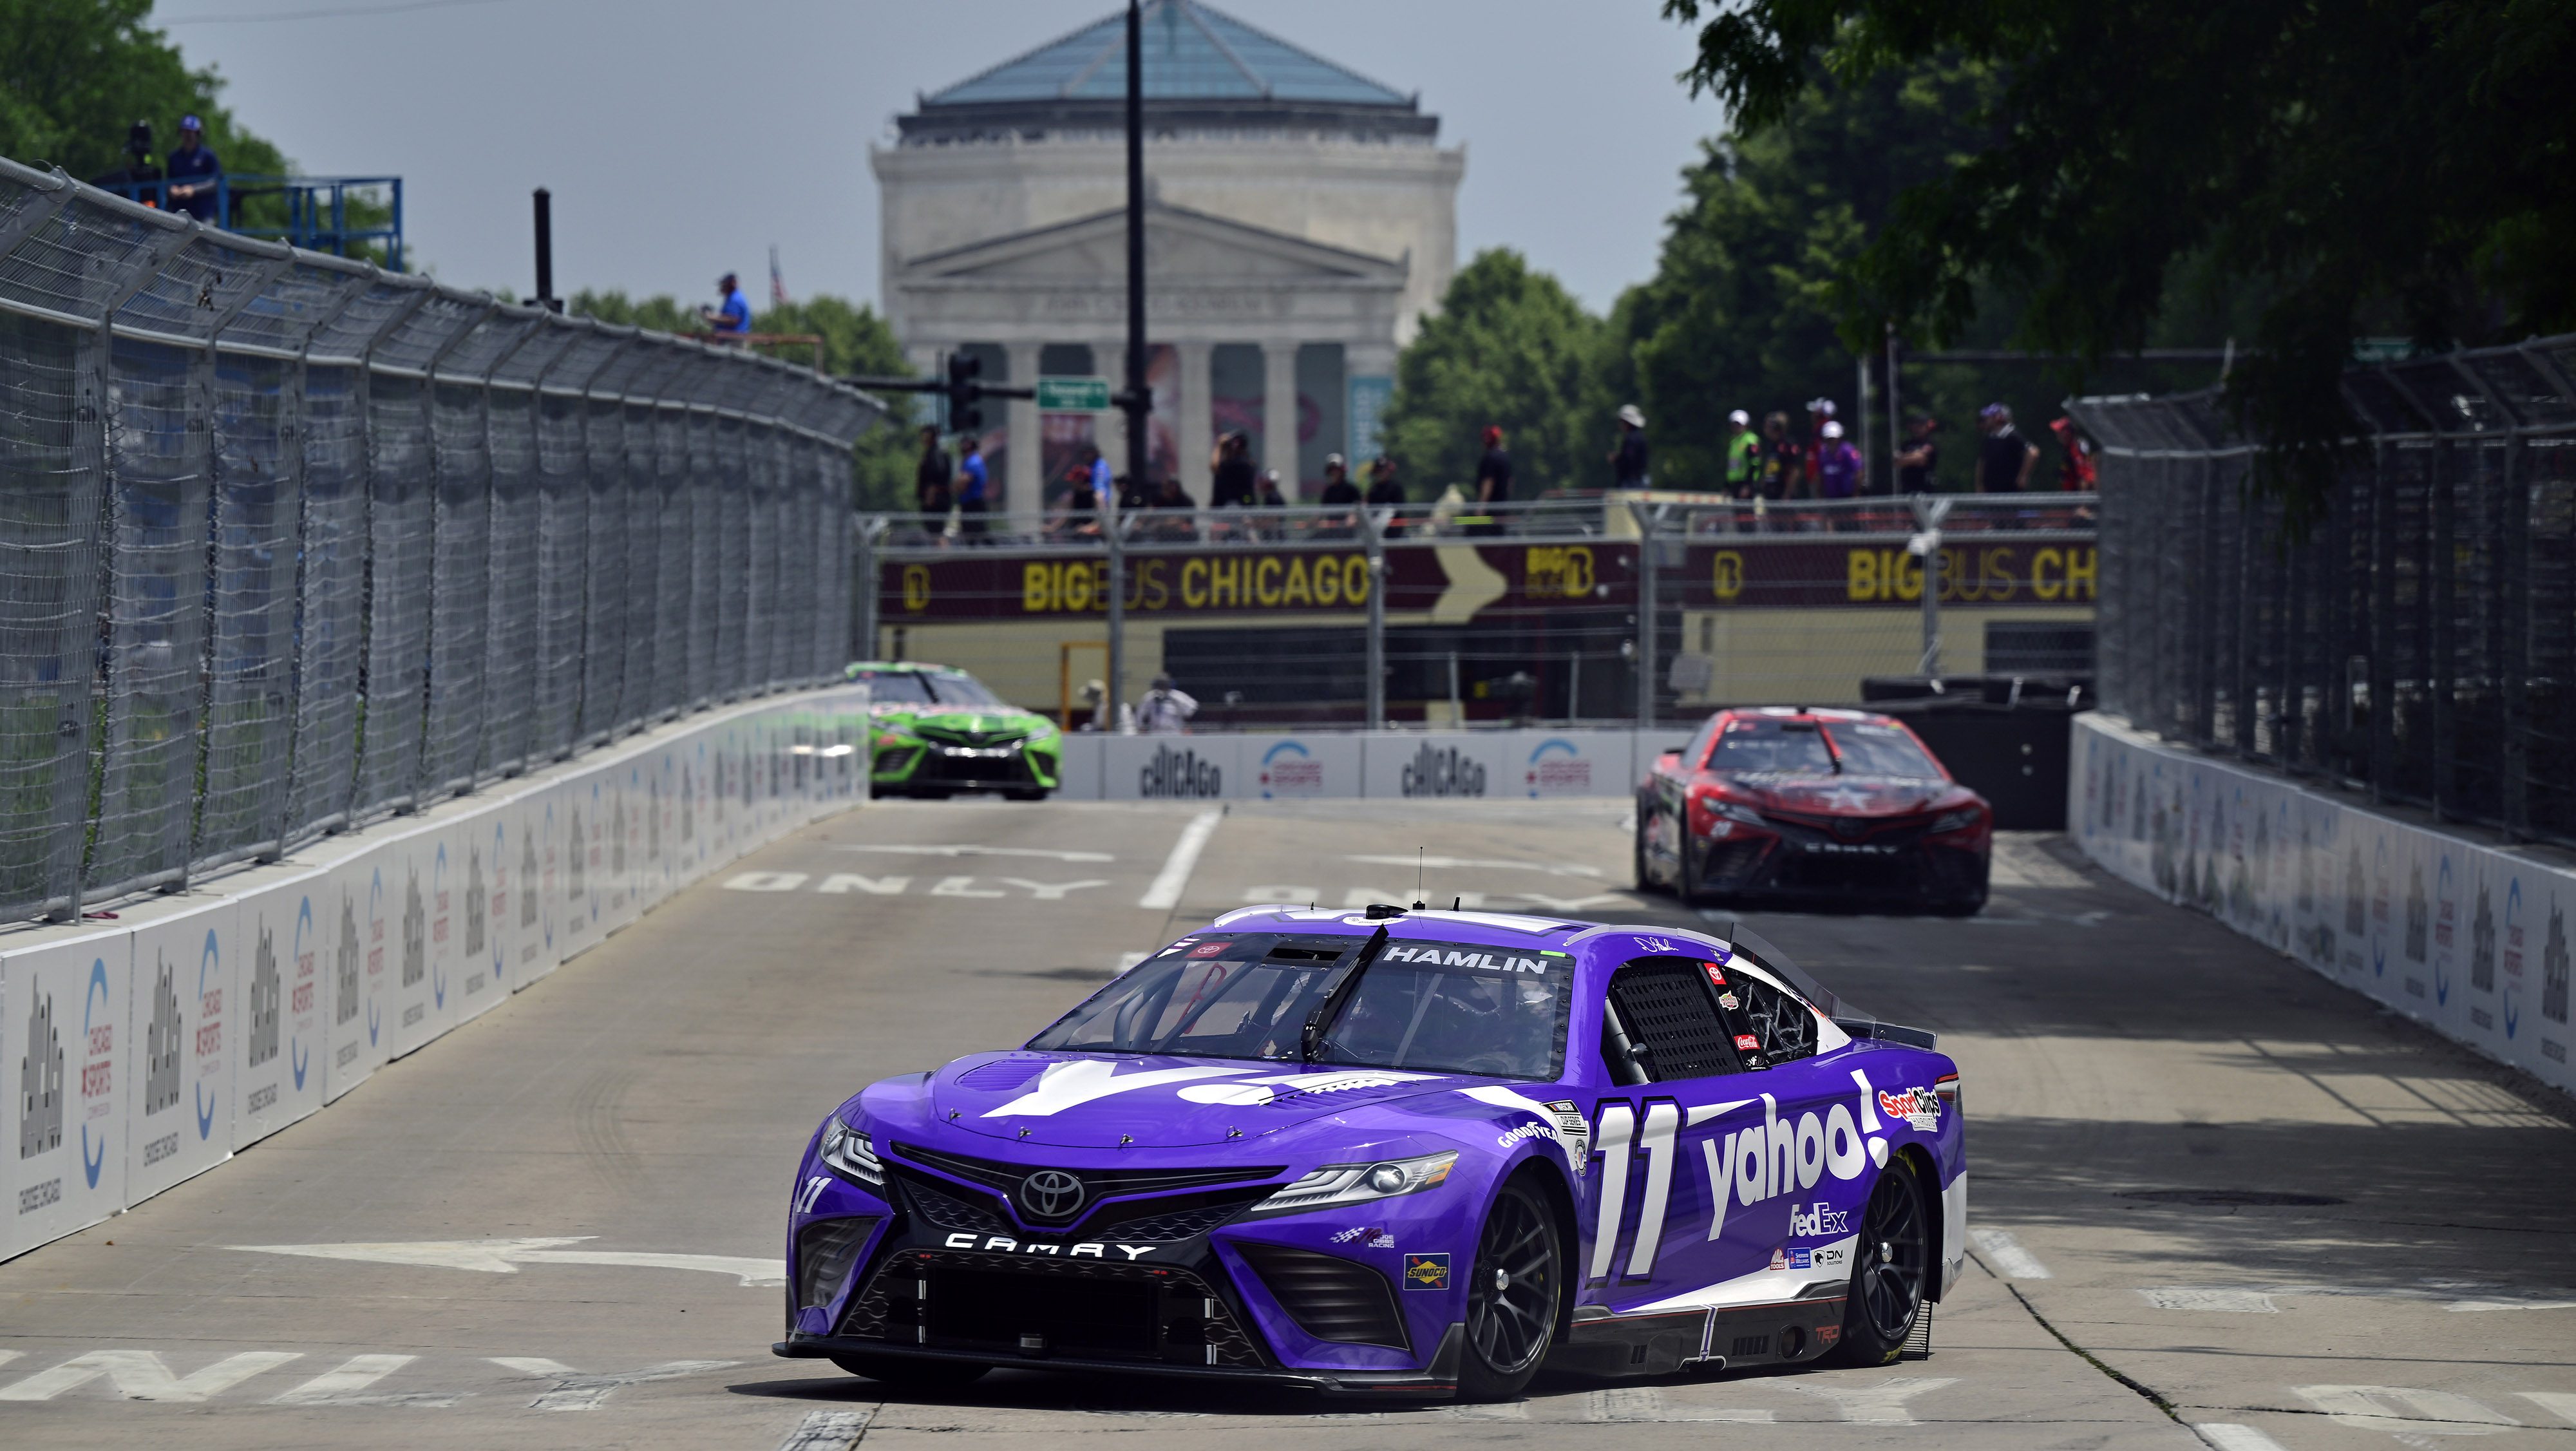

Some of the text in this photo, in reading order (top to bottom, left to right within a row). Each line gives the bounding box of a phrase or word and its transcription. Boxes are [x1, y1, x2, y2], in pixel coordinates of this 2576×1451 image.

[1181, 555, 1370, 609] CHICAGO
[1141, 742, 1220, 797] CHICAGO
[1401, 739, 1486, 797] CHICAGO
[723, 871, 1111, 899] ONLY
[1383, 946, 1548, 974] HAMLIN
[1589, 1068, 1888, 1278] 11 yahoo!
[796, 1176, 833, 1214] 11
[1788, 1202, 1850, 1237] FedEx
[945, 1233, 1157, 1260] CAMRY
[1826, 1249, 1843, 1260] DN
[1409, 1267, 1446, 1278] SUNOCO
[1815, 1324, 1840, 1345] TRD
